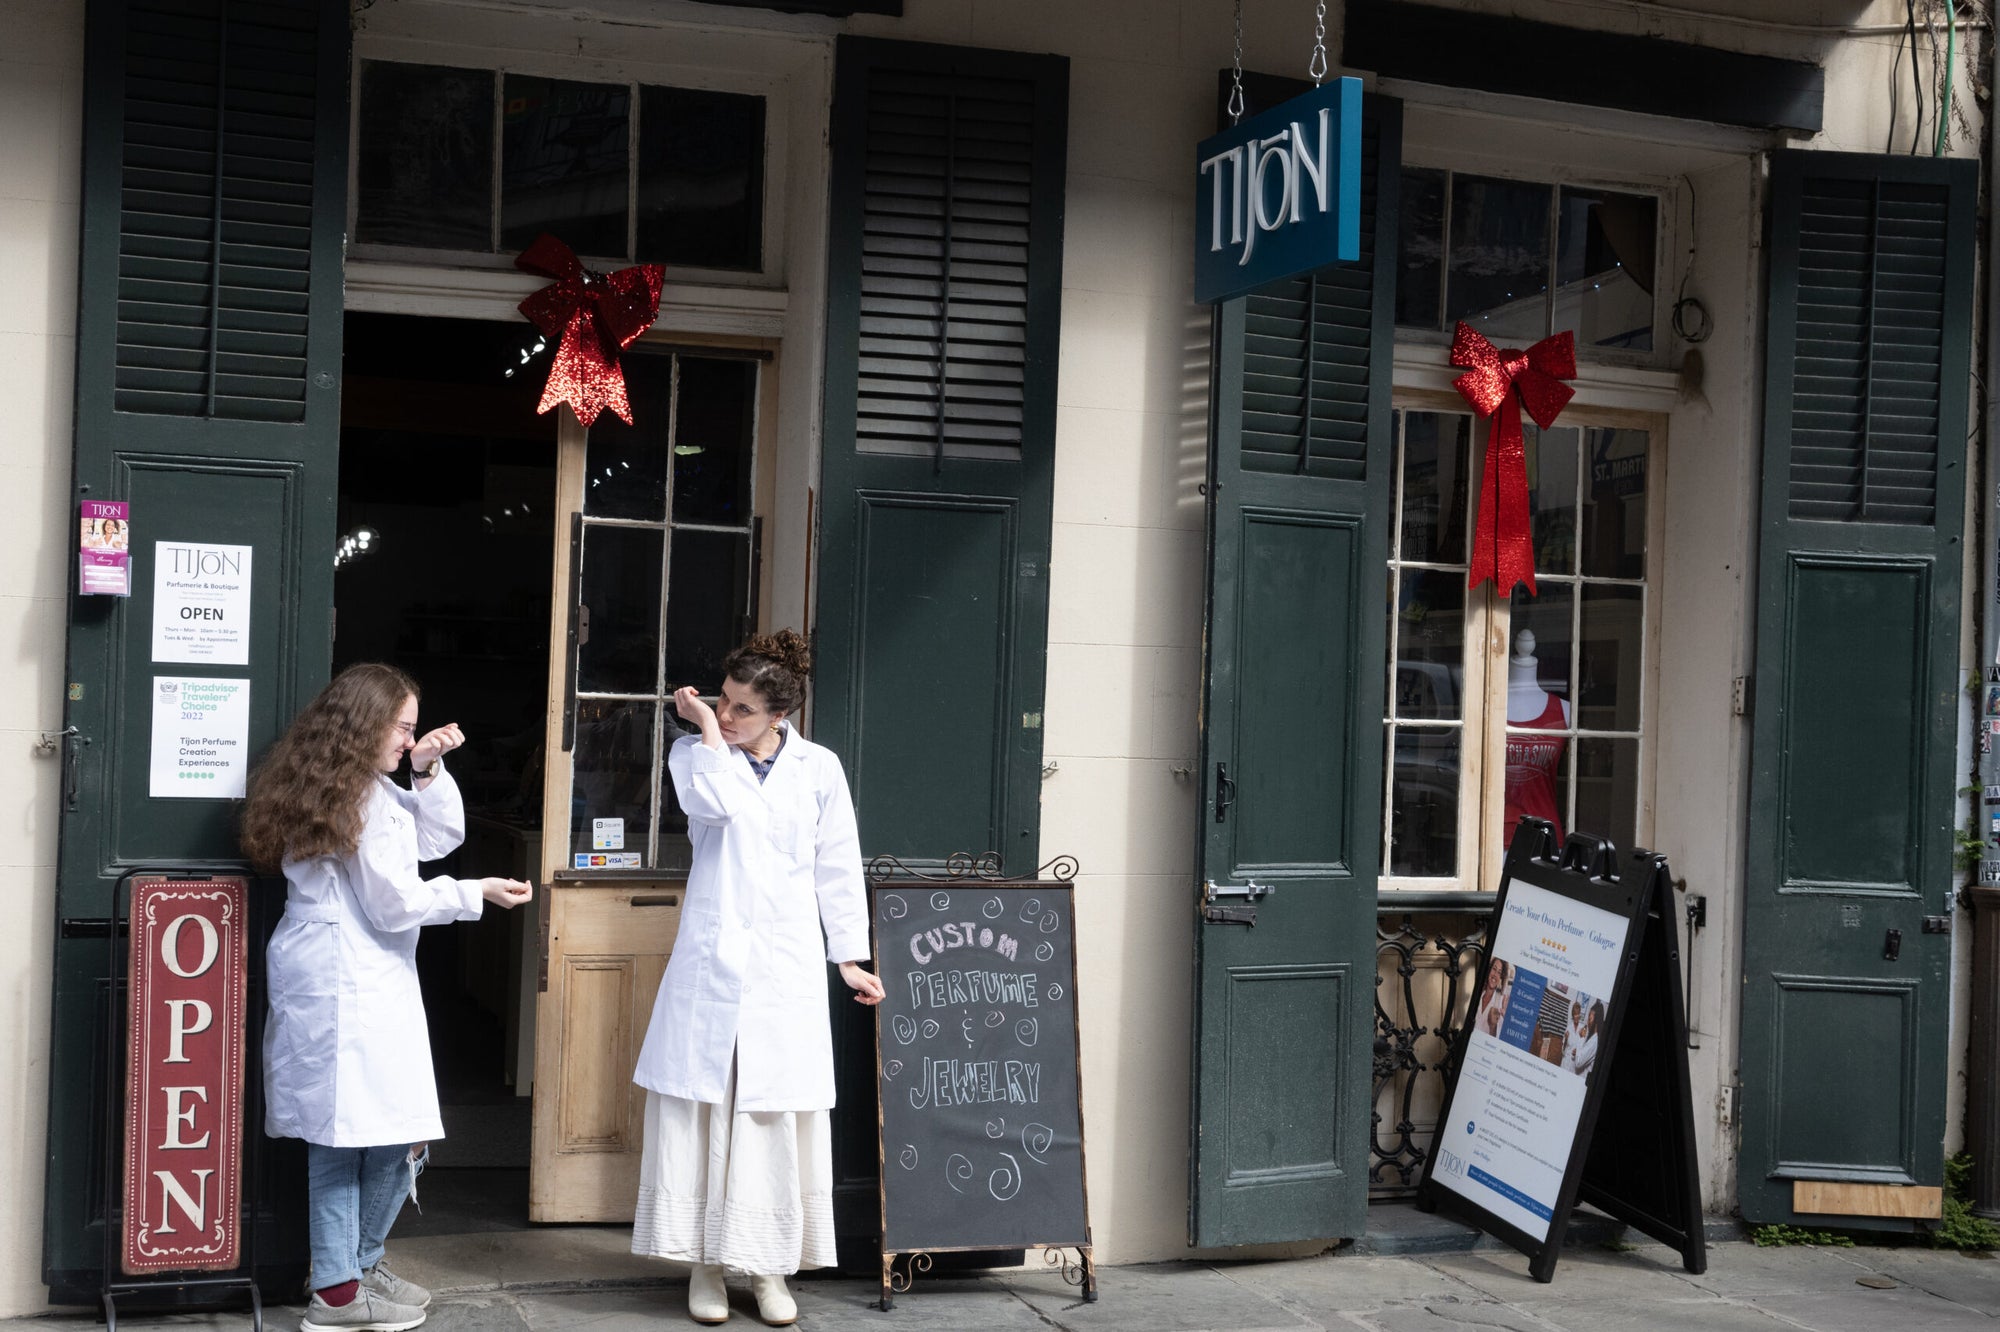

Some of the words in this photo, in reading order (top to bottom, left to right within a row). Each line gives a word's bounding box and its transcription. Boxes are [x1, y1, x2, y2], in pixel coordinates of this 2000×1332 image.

[1612, 457, 1645, 480] MARTI
[166, 581, 202, 589] Parfumerie
[210, 583, 239, 591] Boutique
[180, 606, 224, 621] OPEN
[181, 682, 239, 692] Tripadvisor
[181, 702, 217, 711] Choice
[181, 711, 203, 720] 2022
[180, 737, 200, 746] Tijon
[202, 738, 237, 746] Perfume
[179, 748, 216, 756] Creation
[178, 759, 230, 767] Experiences
[1505, 900, 1525, 916] Create
[1526, 906, 1540, 921] Your
[1541, 913, 1557, 928] Own
[1557, 918, 1584, 937] Perfume
[1589, 930, 1616, 950] Cologne
[910, 922, 1018, 964] CUSTOM
[908, 970, 1039, 1009] PERFUME
[153, 913, 220, 1235] OPEN
[910, 1056, 1041, 1110] JEWELRY
